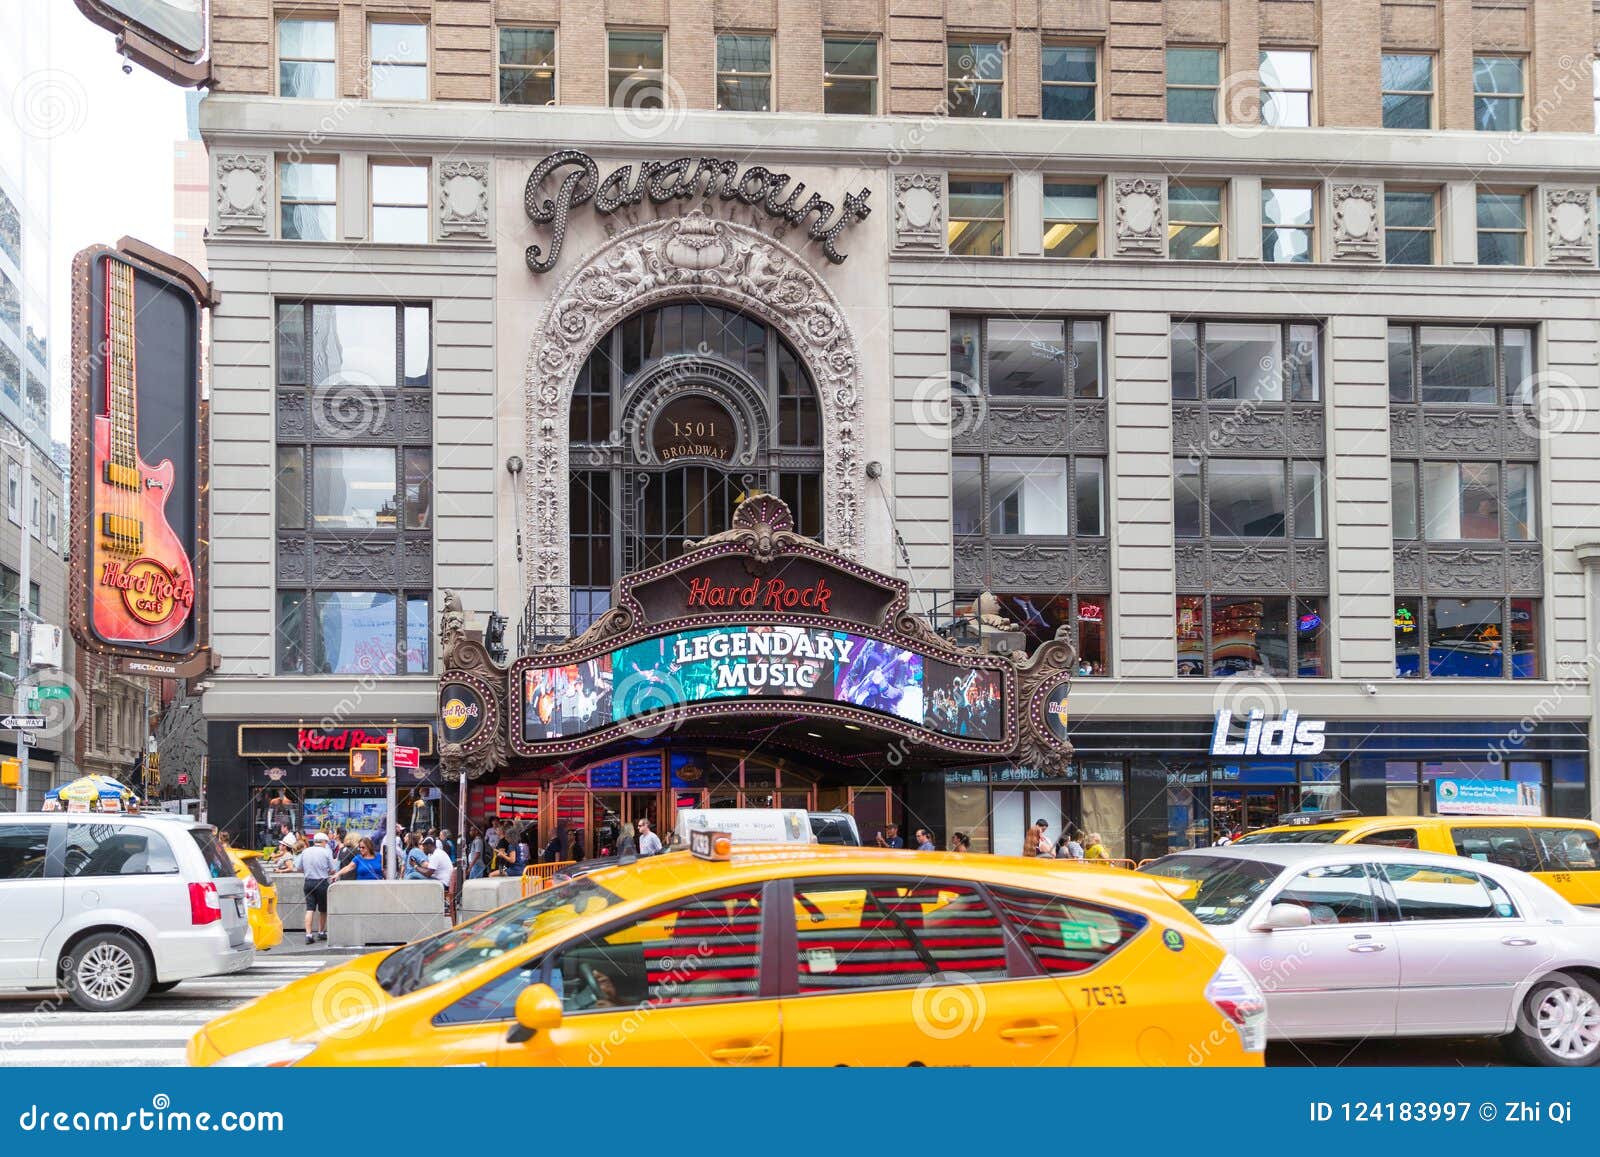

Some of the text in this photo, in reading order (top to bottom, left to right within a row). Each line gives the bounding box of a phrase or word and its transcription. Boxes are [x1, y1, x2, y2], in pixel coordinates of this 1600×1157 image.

[524, 150, 873, 273] Paramount
[674, 422, 715, 437] 1501
[662, 445, 728, 460] BROADWAY
[102, 562, 194, 608] Hard Rock
[688, 577, 832, 614] Hard Rock
[136, 599, 163, 613] CAFE
[675, 632, 854, 664] LEGENDARY
[129, 662, 176, 674] SPECTACOLOR
[717, 664, 814, 688] MUSIC
[454, 703, 478, 717] Rock
[297, 729, 397, 750] Hard Roc
[1209, 709, 1326, 756] Lids
[311, 767, 347, 777] ROCK
[1081, 985, 1126, 1007] 7C93
